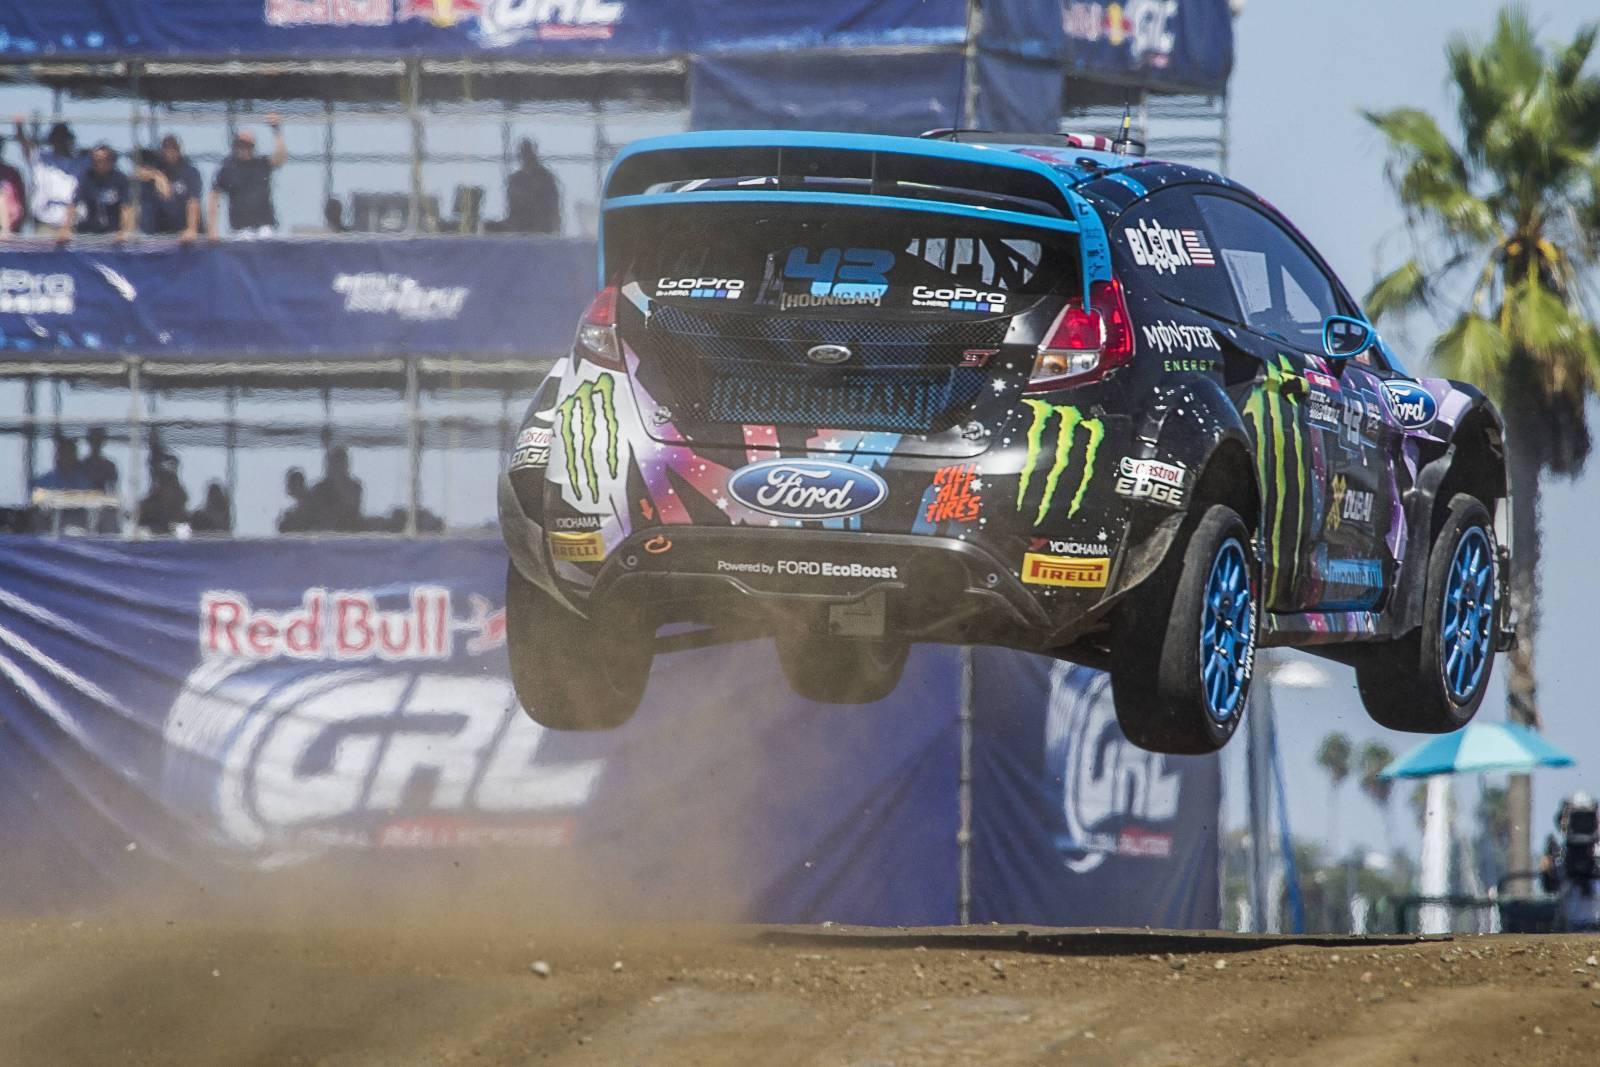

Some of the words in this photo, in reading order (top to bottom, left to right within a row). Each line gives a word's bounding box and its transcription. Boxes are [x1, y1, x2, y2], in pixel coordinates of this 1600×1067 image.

[784, 246, 896, 291] 43
[657, 277, 745, 290] GoPro
[912, 285, 1007, 304] GoPro
[1142, 320, 1222, 354] MONSTER
[1164, 360, 1217, 372] ENERGY
[1388, 389, 1427, 422] Ford
[933, 463, 977, 486] KILL
[757, 466, 856, 510] Ford
[937, 482, 971, 503] ALL
[1114, 477, 1184, 505] EDGE
[927, 496, 981, 522] TIRES
[1050, 540, 1109, 556] YOKOHAMA
[718, 560, 760, 573] Powered
[761, 561, 775, 575] by
[777, 560, 821, 576] FORD
[822, 562, 898, 579] EcoBoost
[1031, 559, 1104, 582] PIRELLI
[203, 590, 324, 657] Red
[332, 588, 450, 657] Bull
